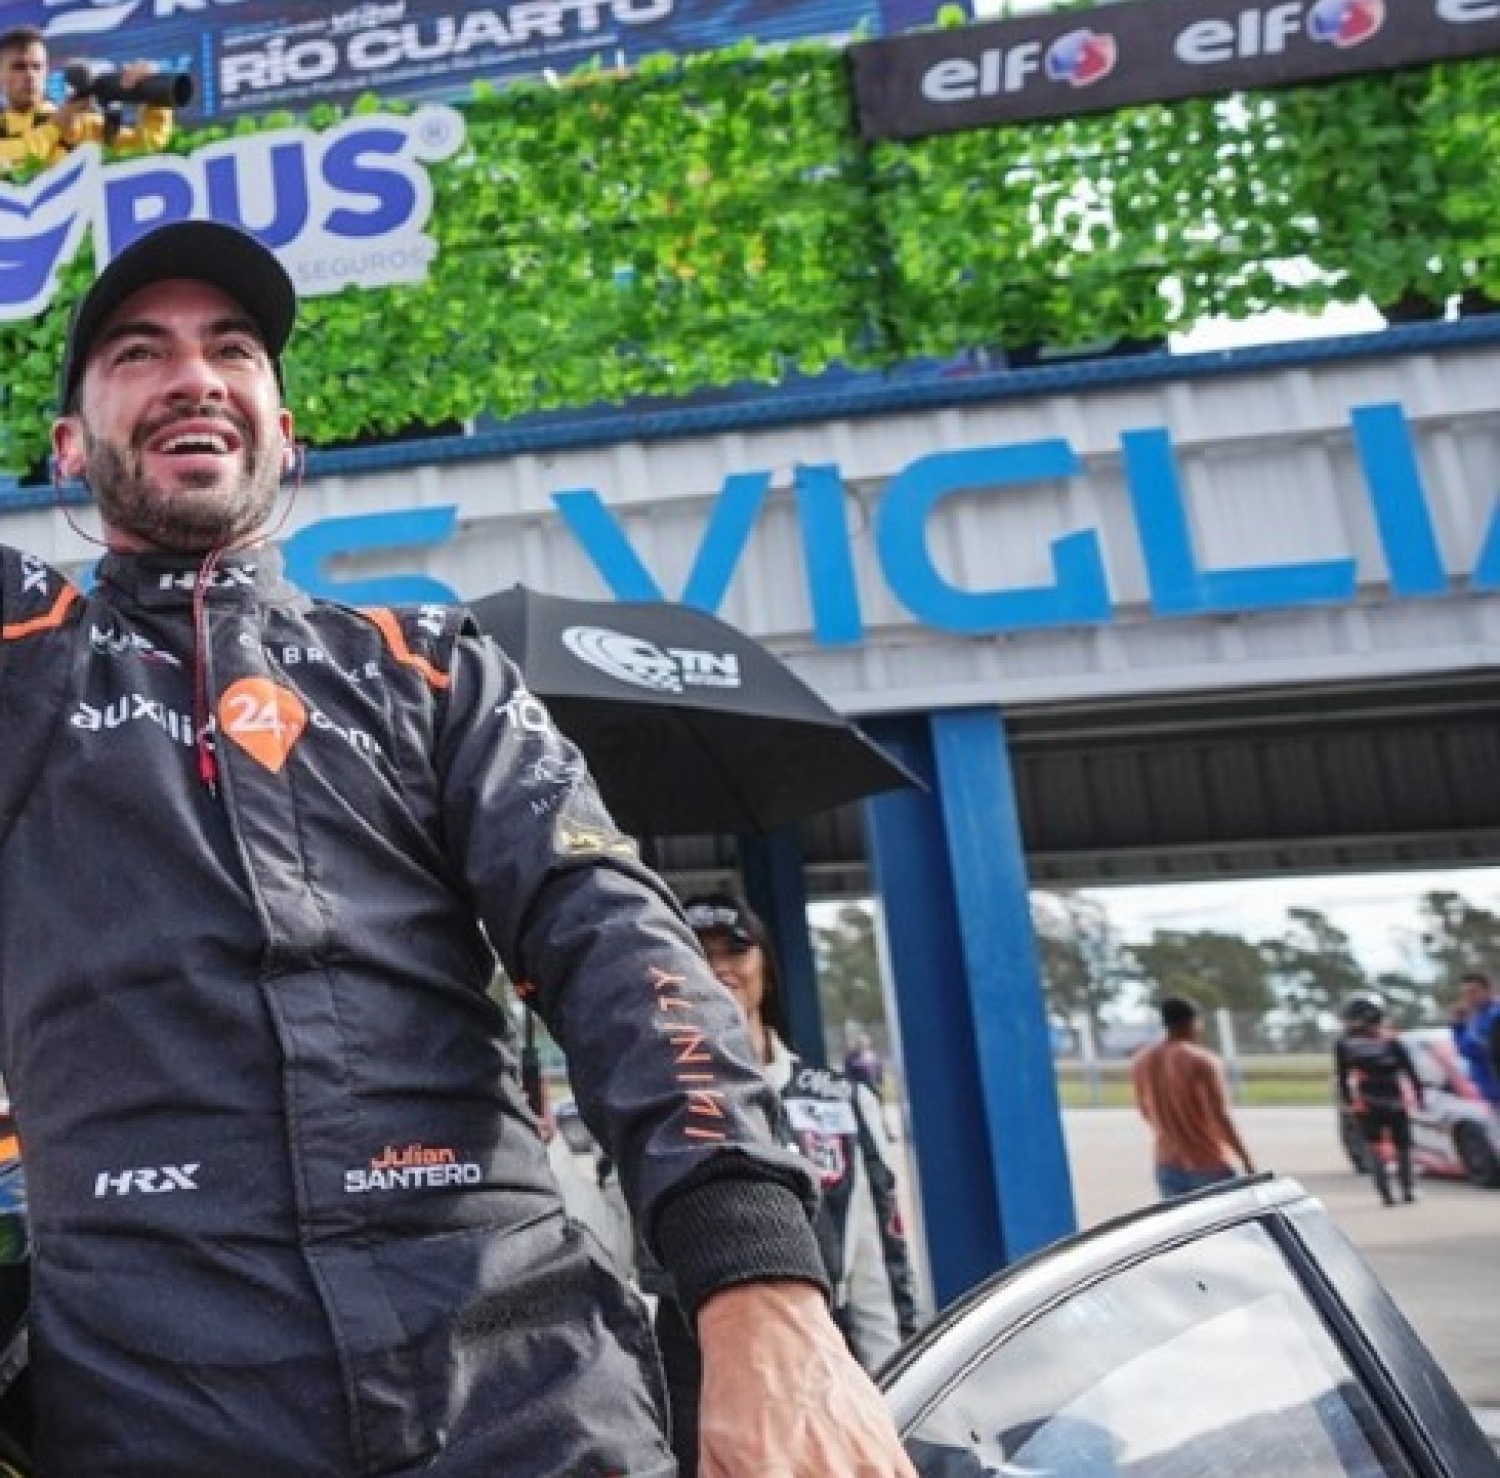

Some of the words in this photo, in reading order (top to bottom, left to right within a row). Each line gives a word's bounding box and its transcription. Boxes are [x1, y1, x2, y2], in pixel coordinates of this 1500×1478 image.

[1173, 2, 1301, 65] elf
[920, 42, 1041, 101] elf
[551, 402, 1500, 649] VIGLI
[666, 648, 739, 673] TN
[227, 692, 285, 740] 24
[371, 1142, 456, 1170] Julian
[94, 1161, 201, 1199] HRX
[344, 1163, 482, 1194] SANTERO
